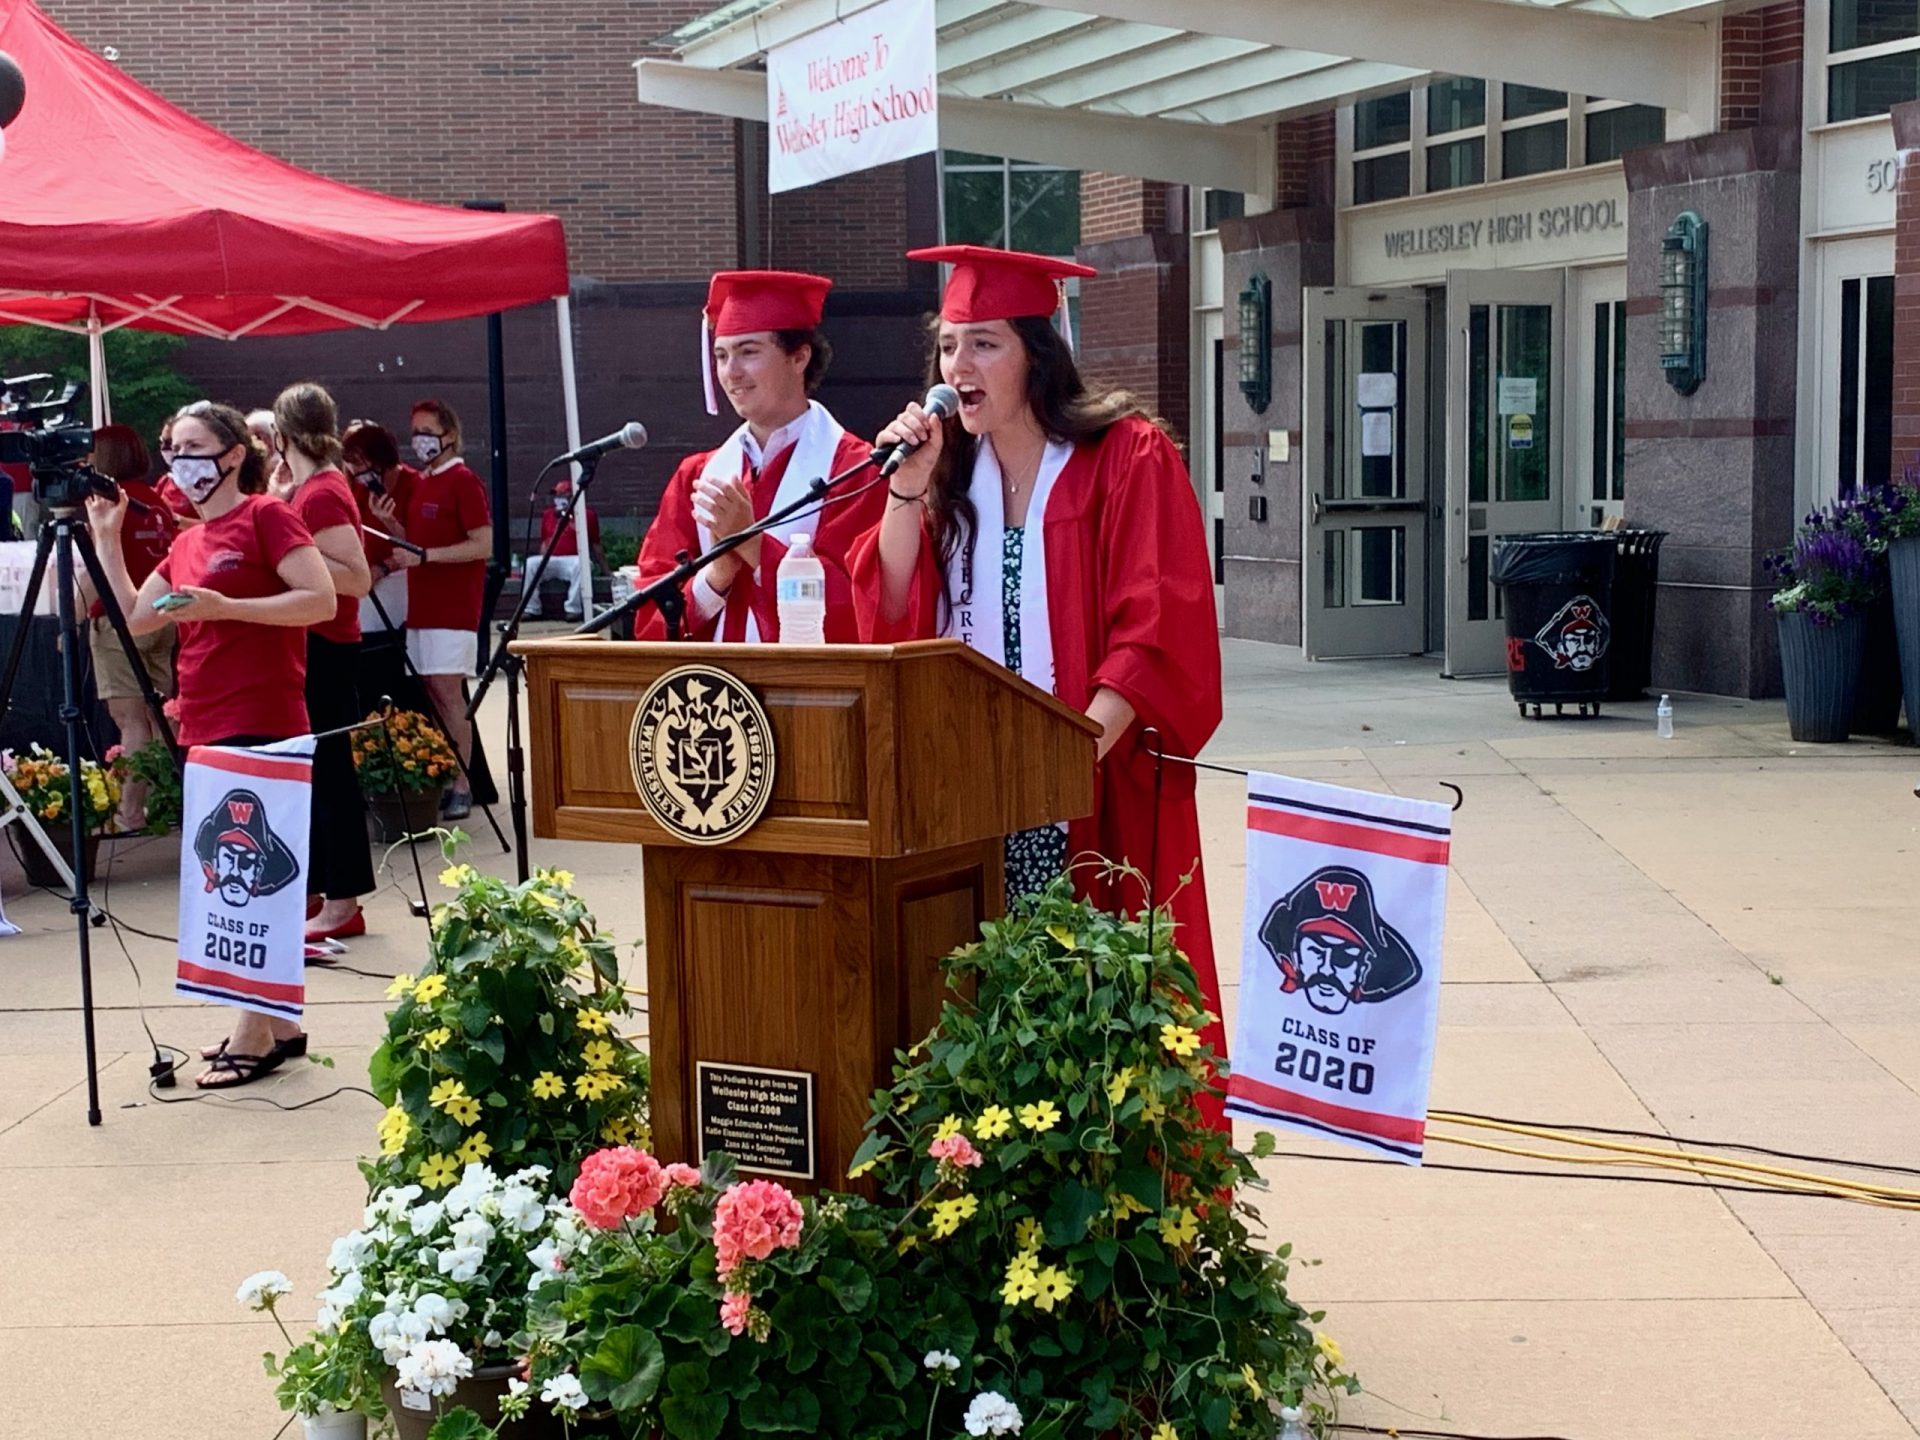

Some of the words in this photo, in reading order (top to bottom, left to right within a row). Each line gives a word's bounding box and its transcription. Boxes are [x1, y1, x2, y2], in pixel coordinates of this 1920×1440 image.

[808, 51, 870, 92] Welcome
[873, 34, 889, 71] To
[833, 94, 868, 144] High
[872, 74, 935, 127] School
[1384, 219, 1482, 258] WELLESLEY
[1488, 212, 1532, 246] HIGH
[1538, 199, 1623, 239] SCHOOL
[1570, 605, 1592, 619] W
[640, 725, 681, 818] WELLESLEY
[228, 801, 254, 825] W
[727, 779, 760, 822] APRIL
[1315, 880, 1357, 911] W
[207, 912, 244, 935] CLASS
[249, 922, 269, 938] OF
[204, 932, 267, 970] 2020
[1282, 1017, 1340, 1049] CLASS
[1347, 1036, 1376, 1055] OF
[709, 1073, 722, 1083] This
[723, 1074, 747, 1085] Podium
[760, 1079, 771, 1088] gift
[772, 1080, 786, 1089] from
[787, 1082, 798, 1091] the
[1274, 1042, 1375, 1096] 2020
[711, 1085, 749, 1100] Wellesley
[750, 1089, 768, 1102] High
[770, 1091, 797, 1104] School
[727, 1101, 749, 1112] Class
[750, 1104, 759, 1113] of
[760, 1133, 773, 1142] Vice
[775, 1134, 805, 1146] President
[768, 1122, 798, 1134] President
[756, 1143, 786, 1156] Secretary
[764, 1155, 793, 1167] Treasurer
